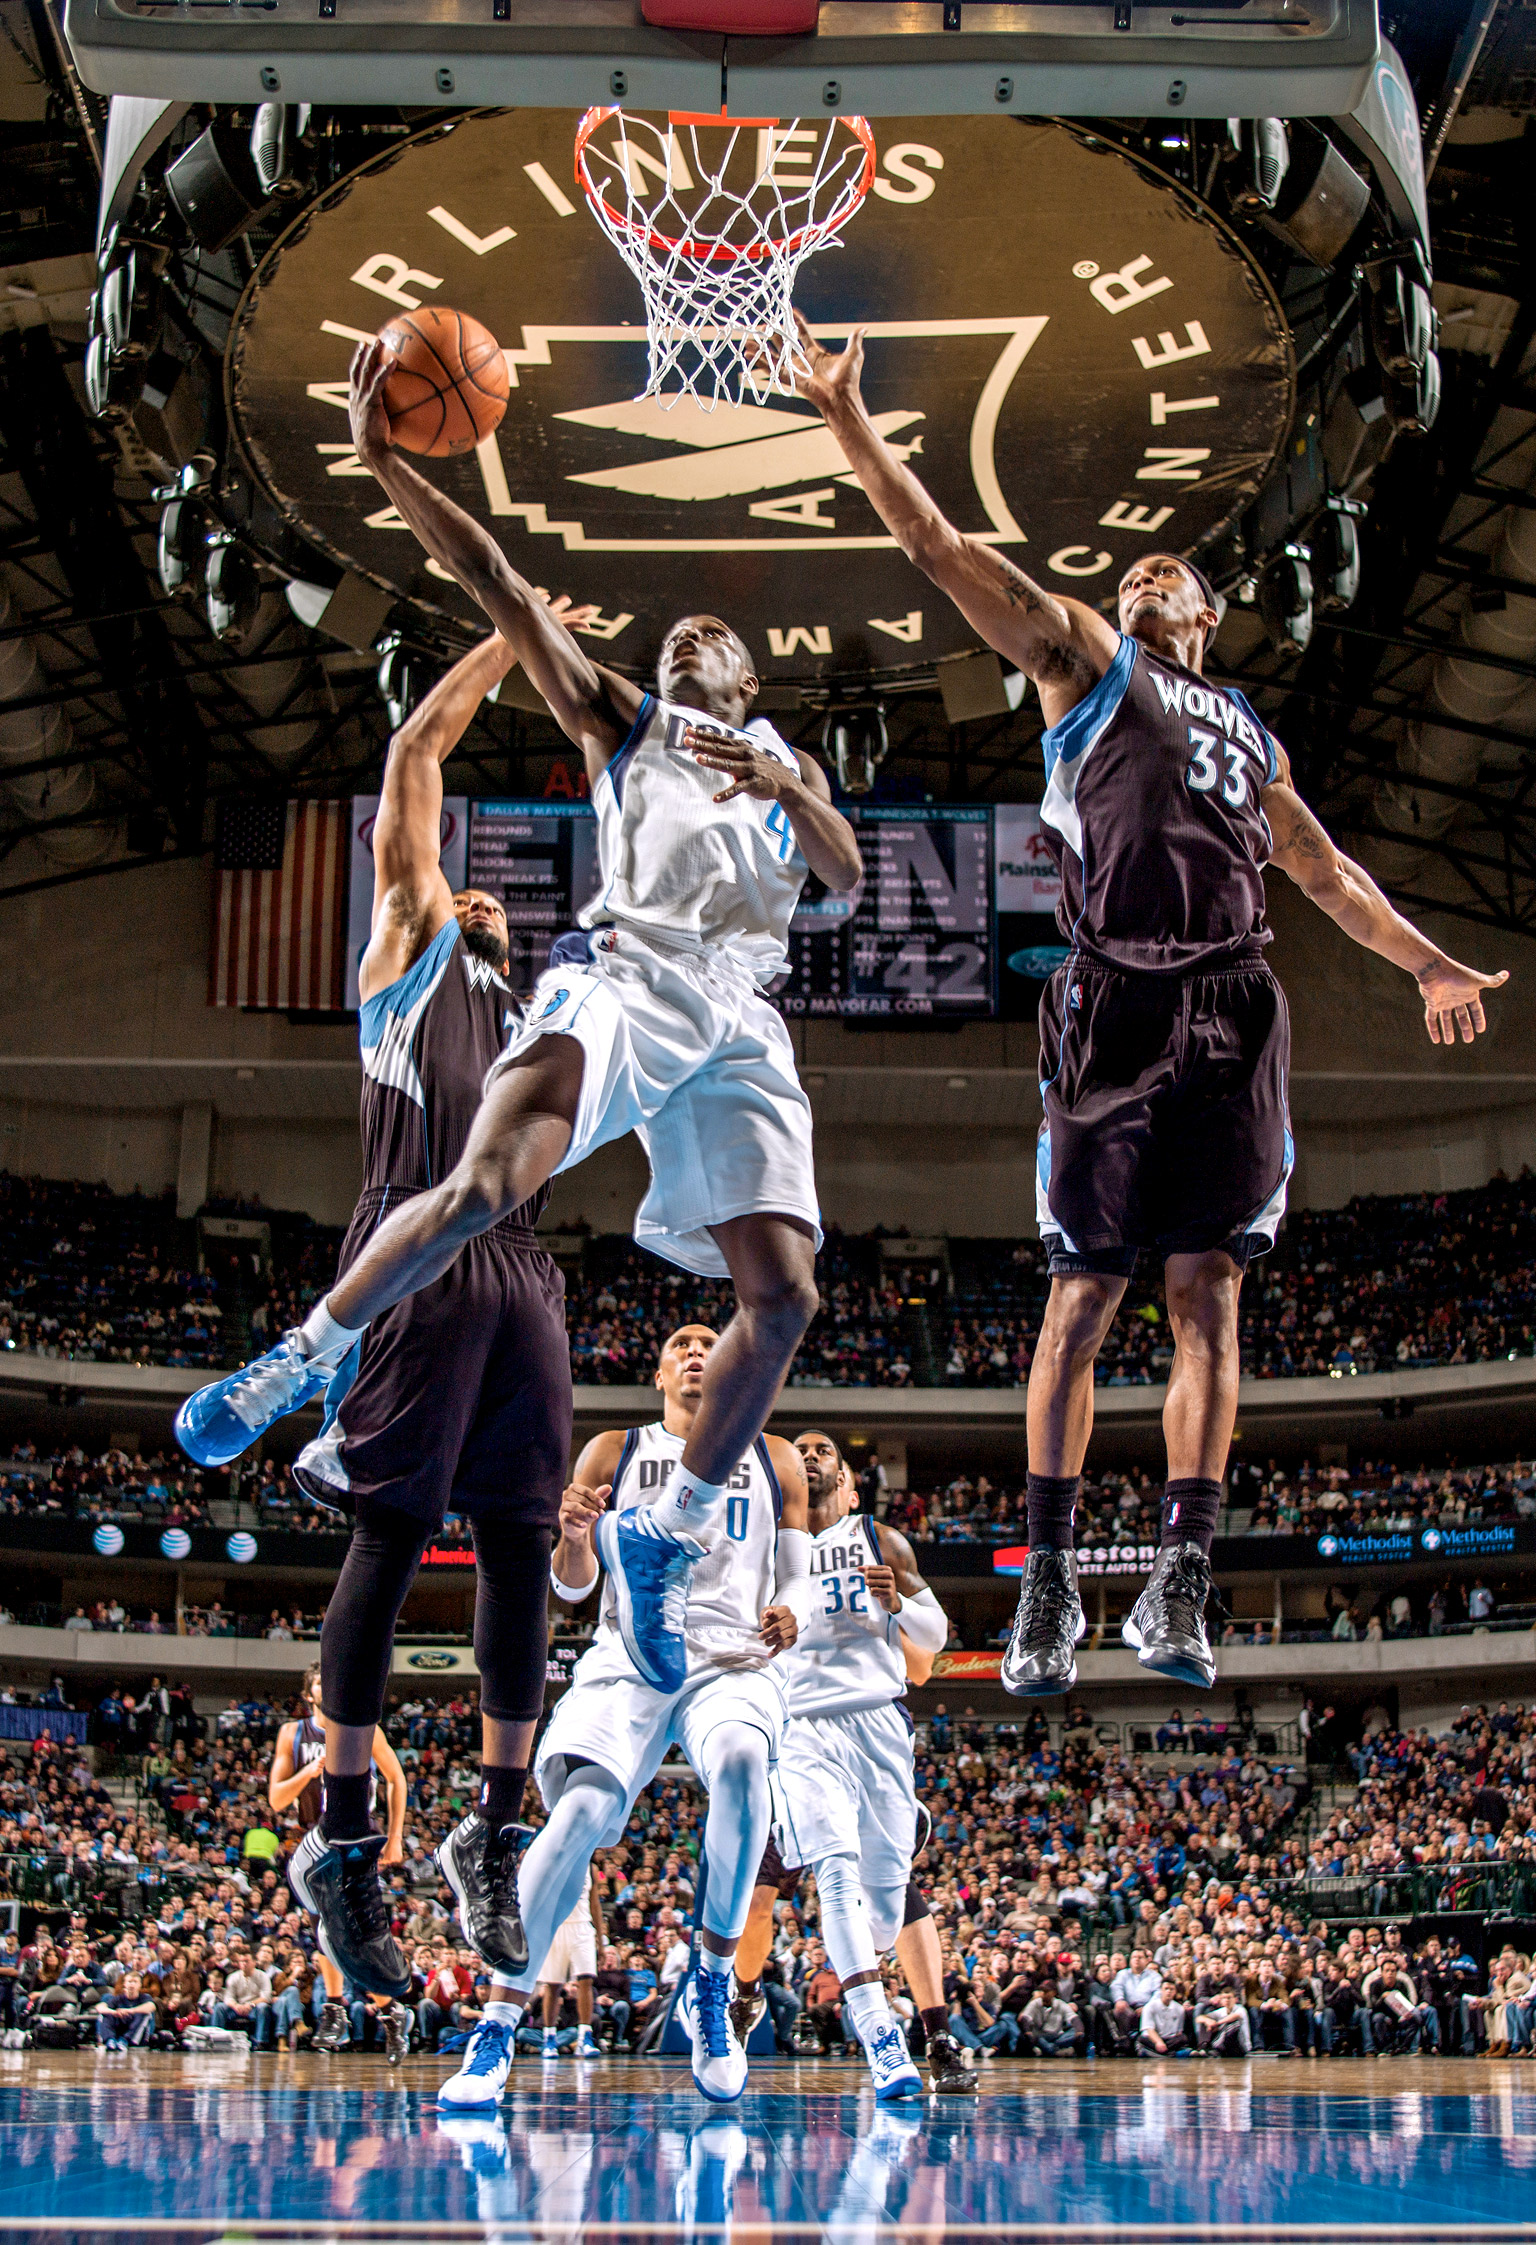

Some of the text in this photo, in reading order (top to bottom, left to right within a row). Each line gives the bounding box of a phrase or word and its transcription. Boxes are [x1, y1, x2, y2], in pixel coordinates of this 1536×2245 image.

[1047, 253, 1220, 578] CENTER
[1148, 672, 1266, 767] WOLVES
[1187, 725, 1248, 808] 33
[484, 805, 594, 817] DALLAS MAVERICK
[472, 825, 533, 837] REBOUNDS
[727, 1496, 750, 1542] 0
[1338, 1533, 1414, 1551] Methodist
[1441, 1525, 1516, 1546] Methodist
[810, 1543, 864, 1575] LLAS
[1076, 1544, 1161, 1562] eston
[1077, 1561, 1154, 1575] LETE AUTO CA
[822, 1575, 868, 1615] 32
[555, 1648, 579, 1661] TOL
